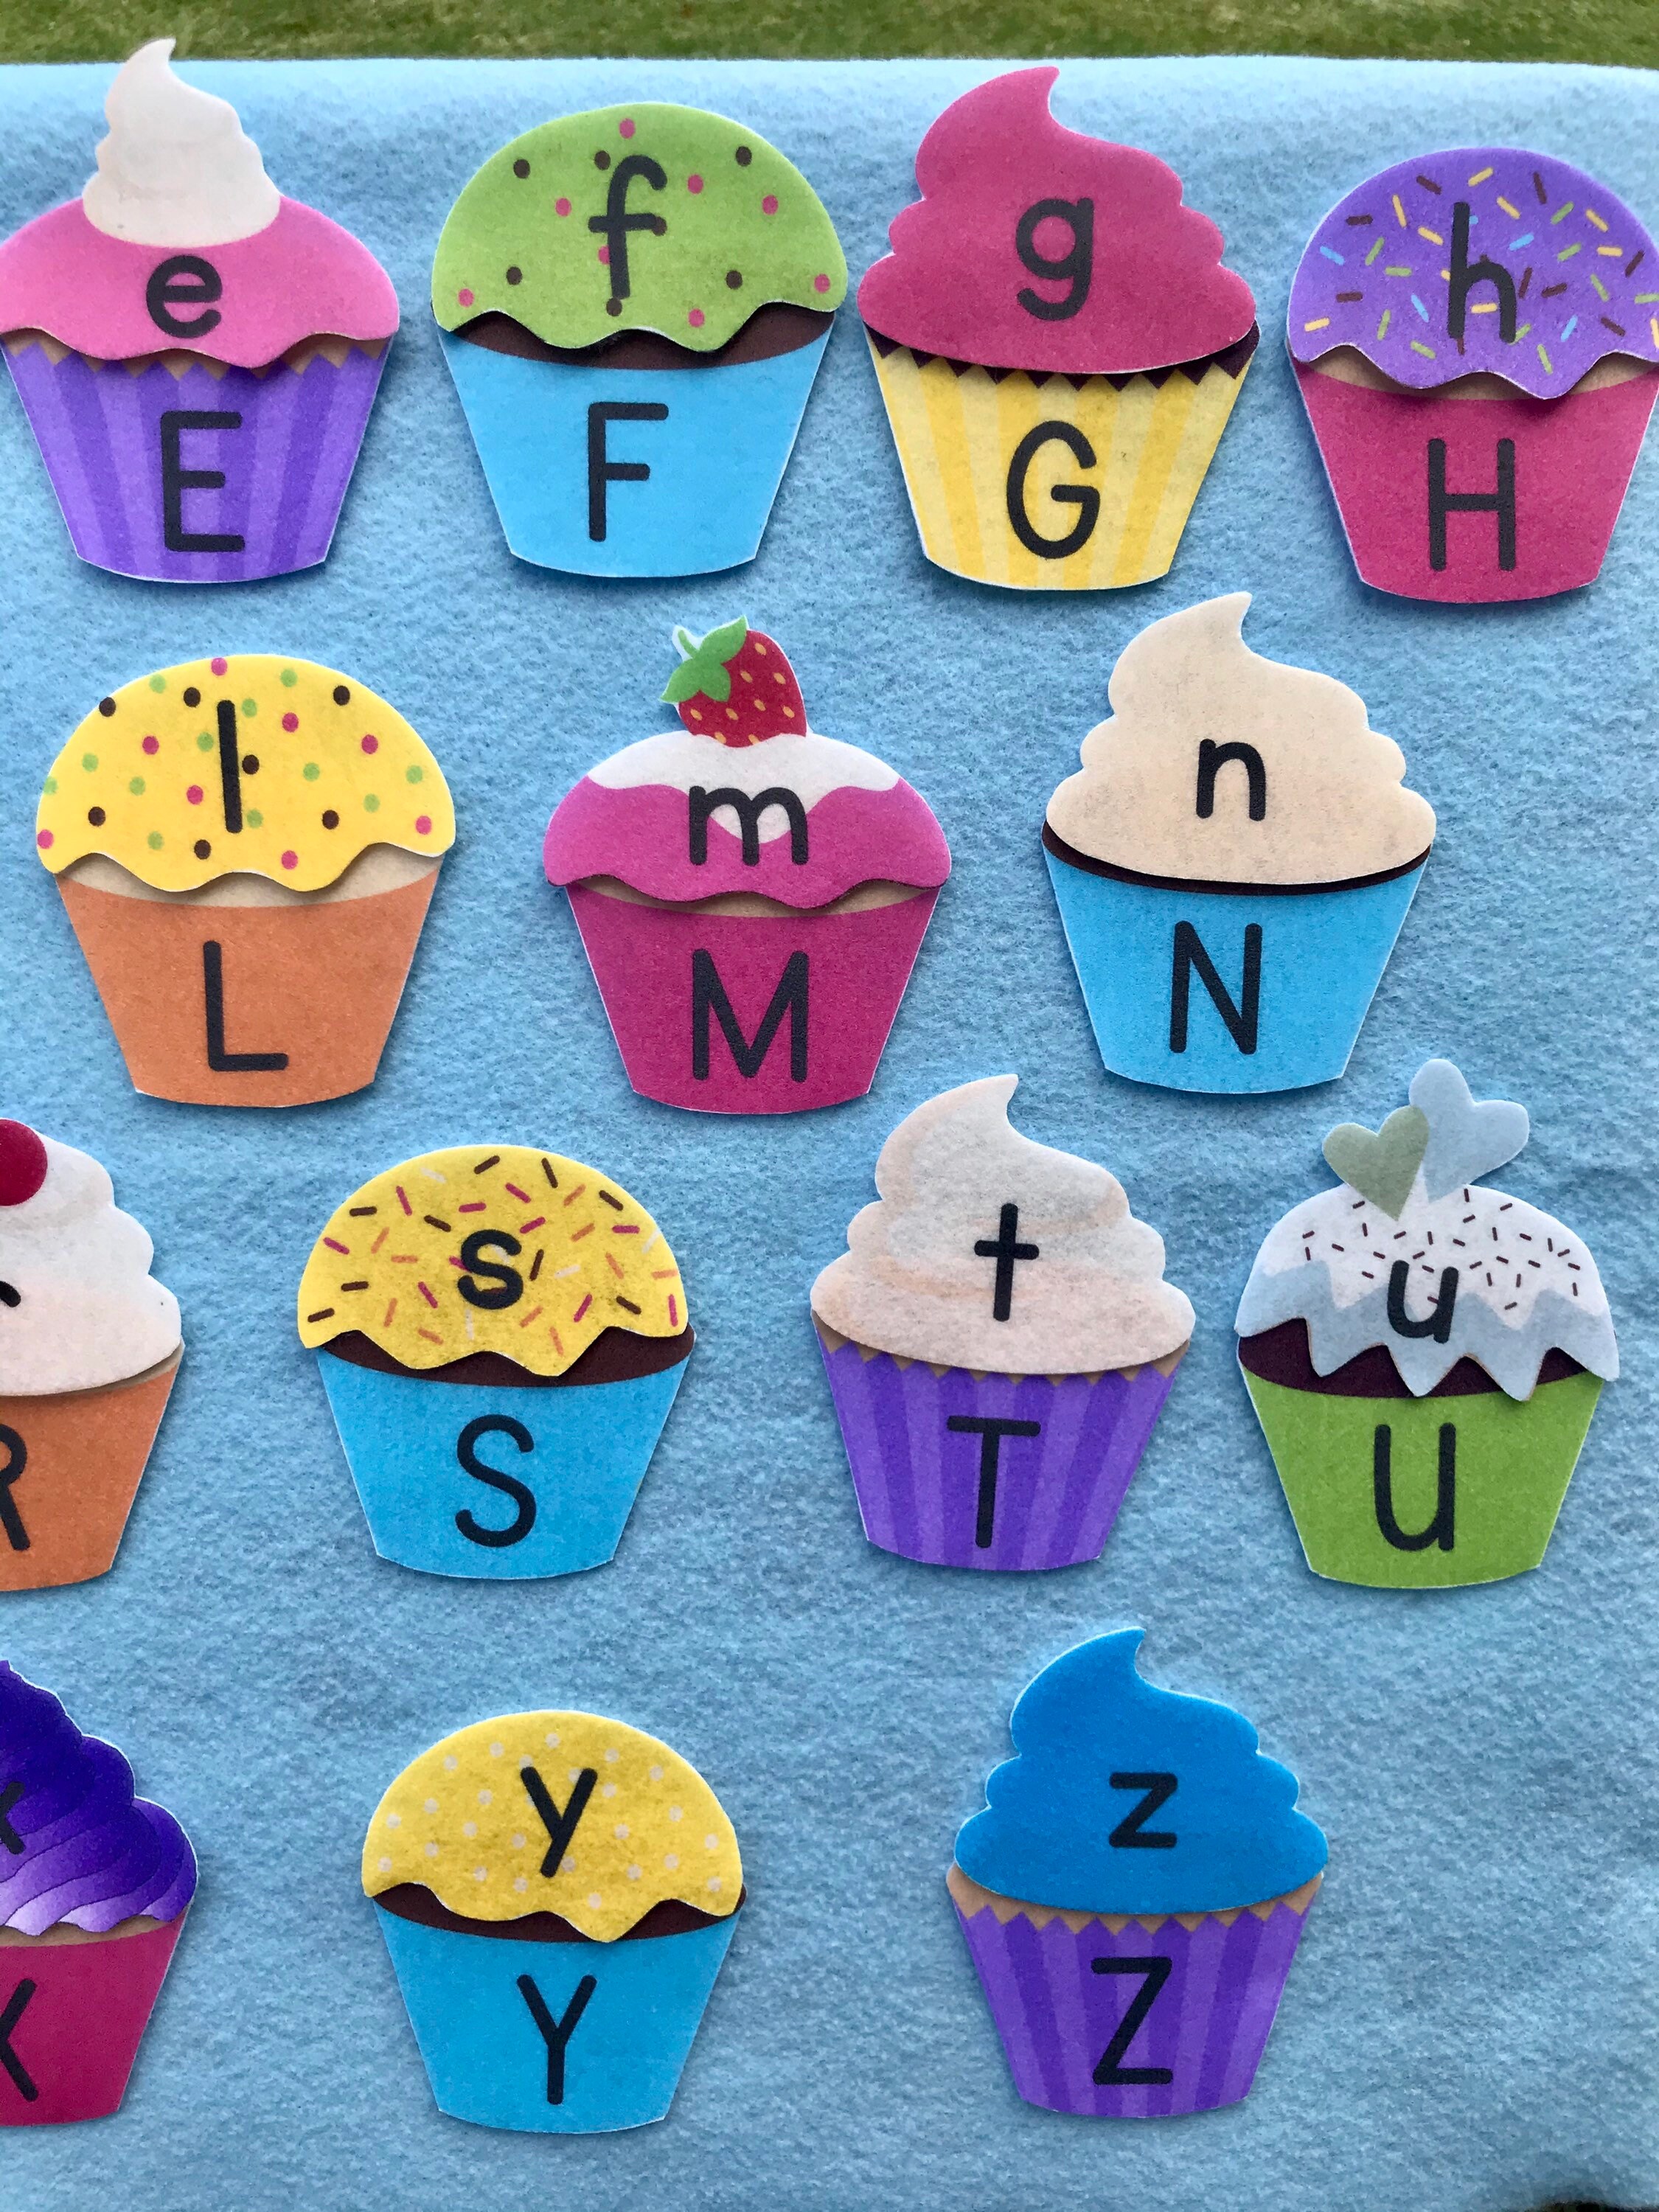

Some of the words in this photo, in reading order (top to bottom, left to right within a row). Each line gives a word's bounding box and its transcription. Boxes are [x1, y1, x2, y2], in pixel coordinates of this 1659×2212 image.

[588, 155, 667, 299] f
[1016, 198, 1093, 321] g
[1448, 203, 1516, 343] h
[147, 255, 221, 338] e
[161, 411, 245, 552] E
[588, 402, 668, 540] F
[1006, 421, 1099, 559] G
[1427, 438, 1516, 571] H
[689, 786, 808, 866] m
[1196, 739, 1266, 821] n
[204, 941, 288, 1071] L
[692, 949, 809, 1085] M
[1170, 921, 1262, 1054] N
[457, 1230, 523, 1310] s
[974, 1203, 1039, 1321] t
[1387, 1261, 1458, 1343] u
[456, 1415, 535, 1547] S
[947, 1416, 1040, 1548] T
[1374, 1422, 1456, 1551] U
[521, 1767, 597, 1878] y
[1110, 1773, 1177, 1848] z
[518, 1975, 597, 2104] Y
[1091, 1956, 1172, 2085] Z
